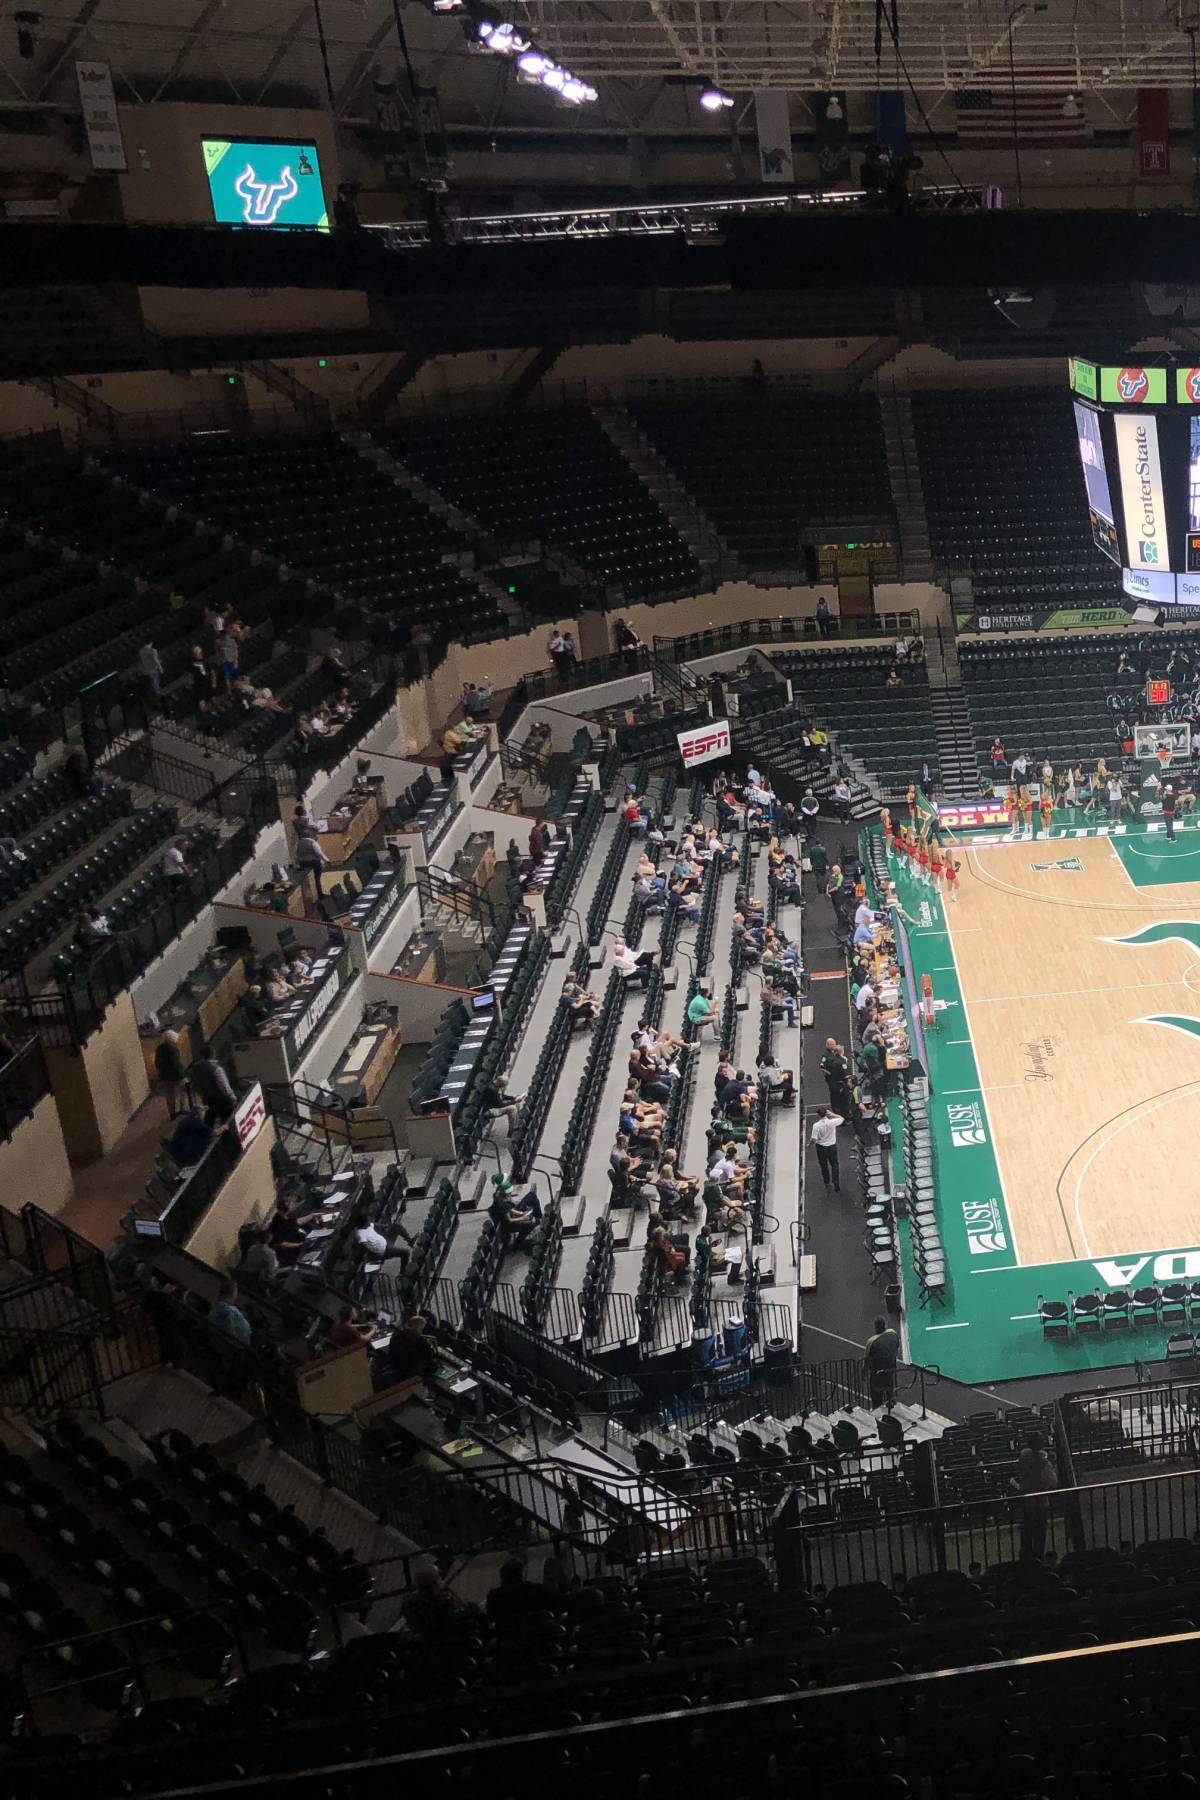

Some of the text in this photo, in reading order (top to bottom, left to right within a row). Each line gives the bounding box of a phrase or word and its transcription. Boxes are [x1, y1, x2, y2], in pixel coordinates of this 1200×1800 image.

[1135, 425, 1157, 539] CenterState
[992, 614, 1033, 624] HERITAGE
[1080, 610, 1117, 623] HERD
[682, 730, 729, 759] ESPN
[971, 824, 1127, 844] SOUTH
[947, 1103, 976, 1132] USF
[962, 1200, 994, 1236] USF
